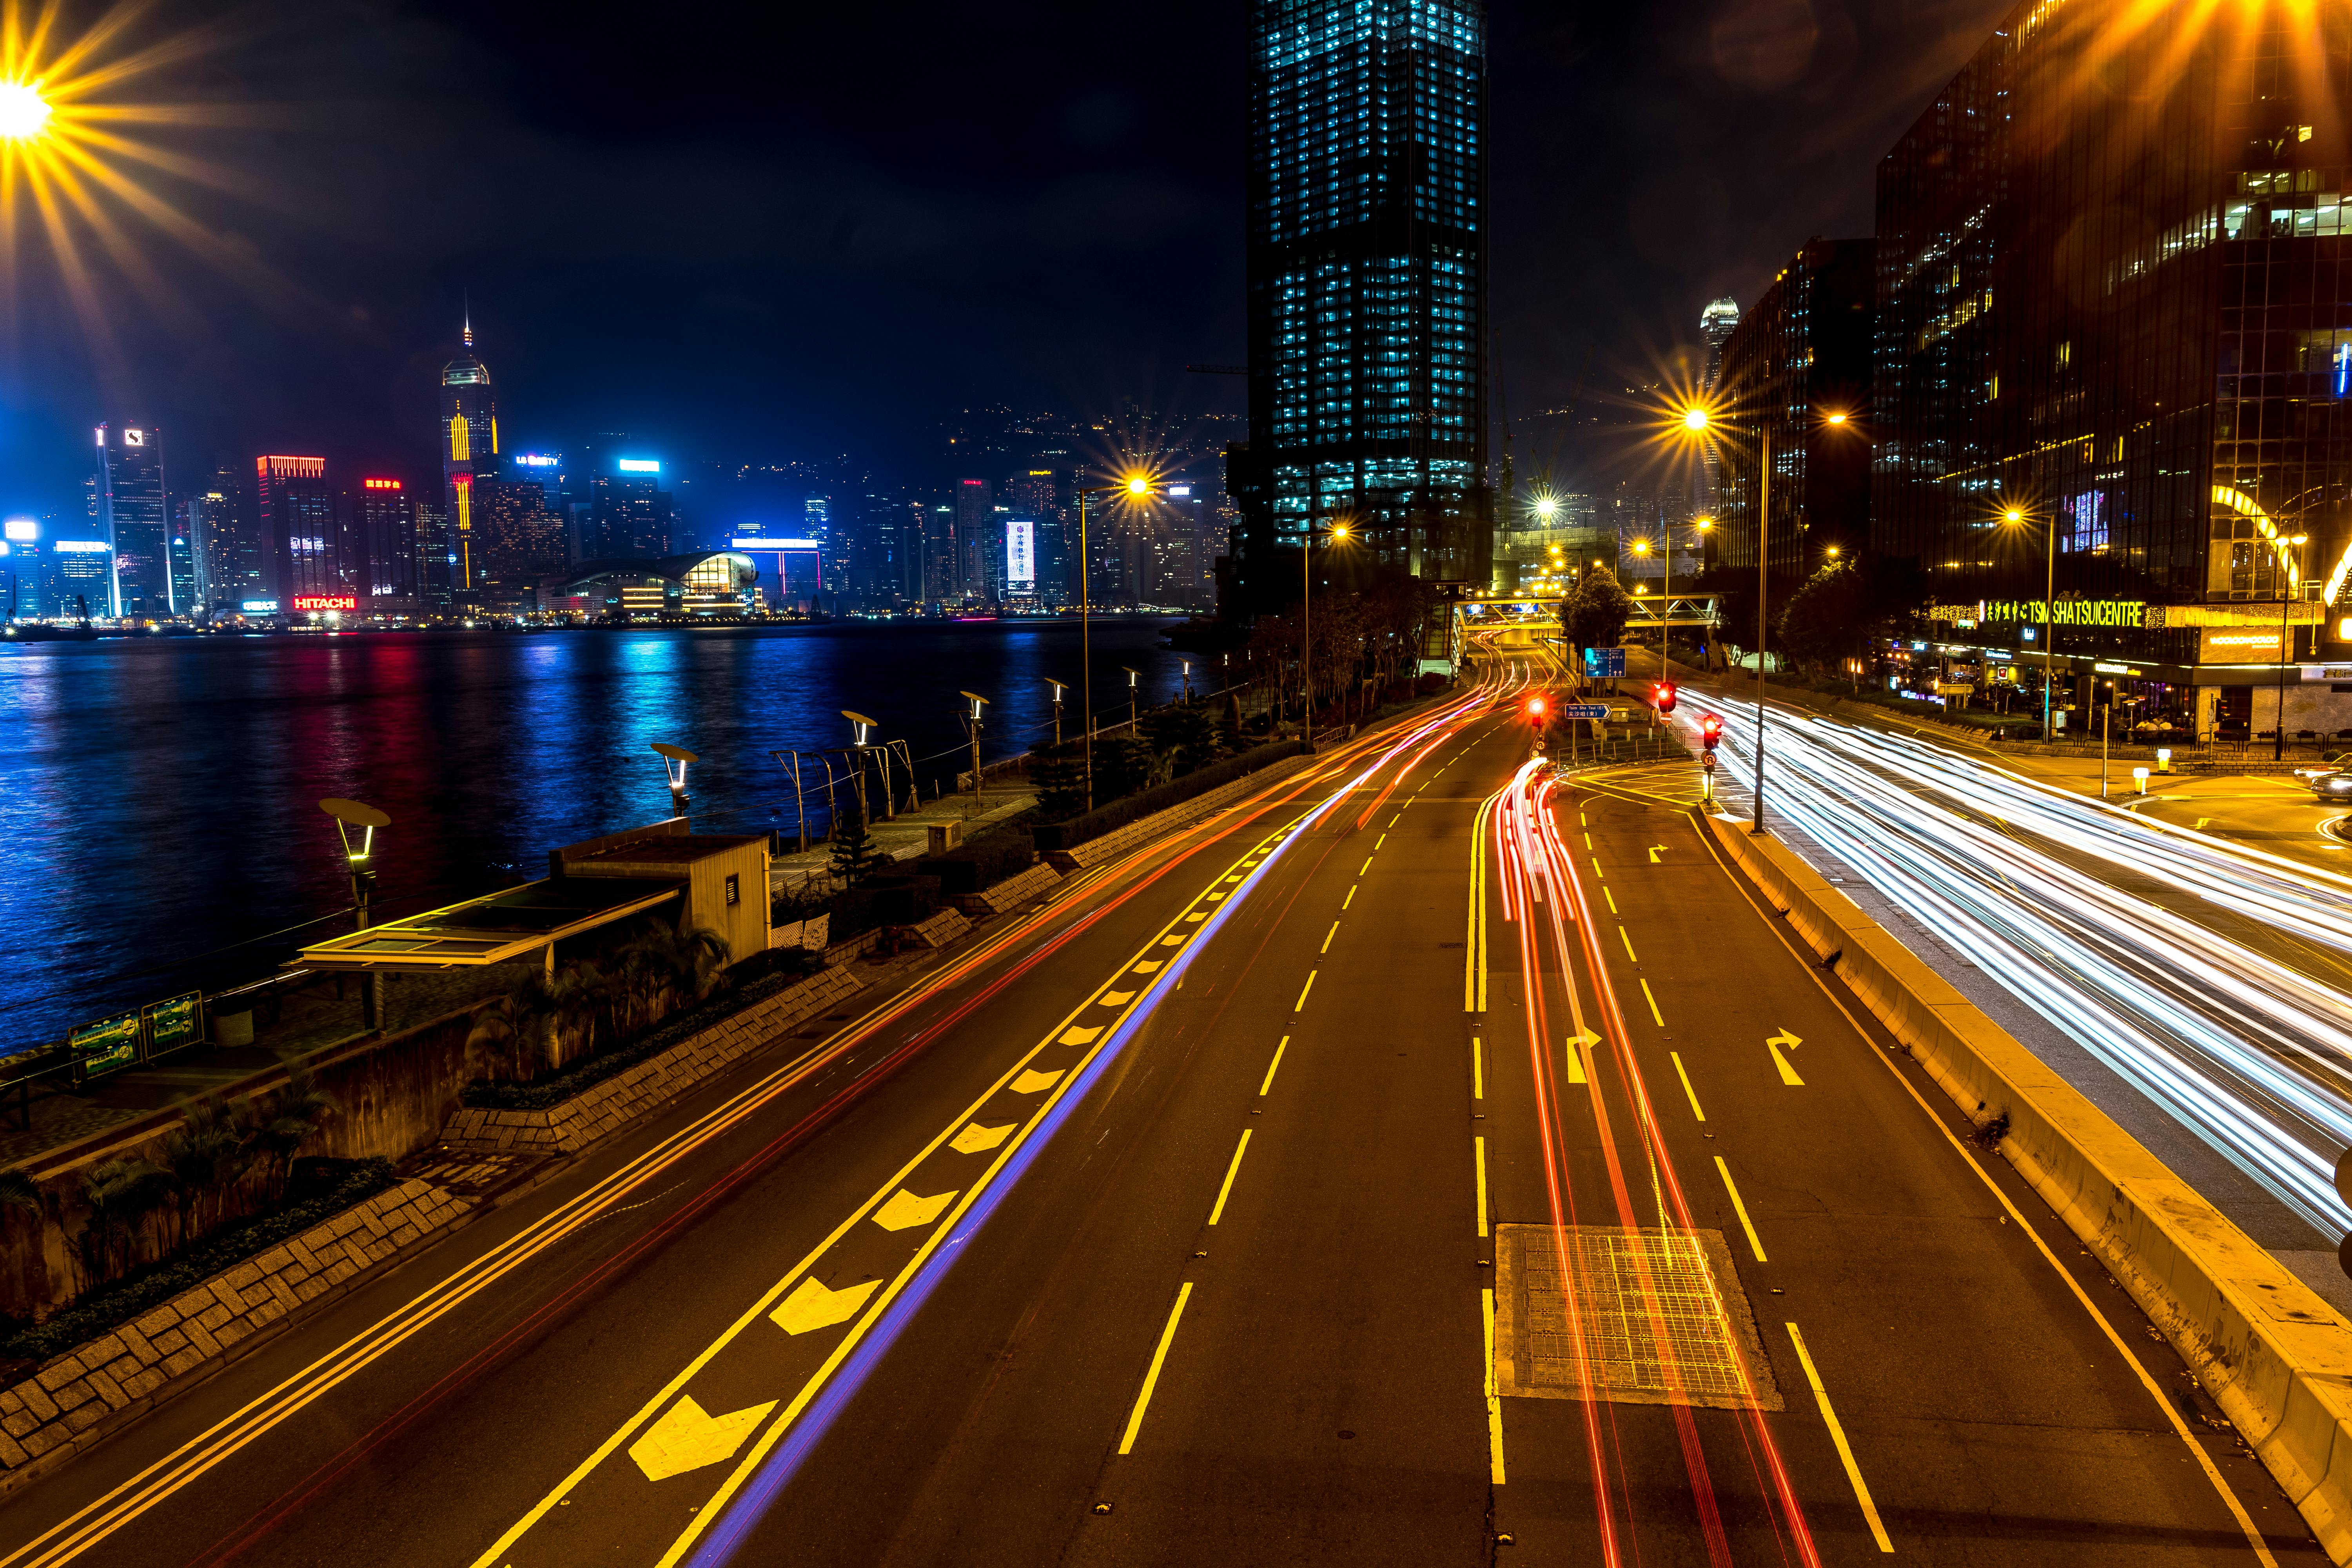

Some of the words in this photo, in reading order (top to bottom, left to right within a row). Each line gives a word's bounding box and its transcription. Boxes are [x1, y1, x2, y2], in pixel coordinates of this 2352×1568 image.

[295, 598, 355, 608] HITACHI
[1987, 601, 2027, 622] 尖沙咀中心
[2053, 601, 2074, 624] SHA
[2075, 600, 2098, 625] TSUI
[2098, 600, 2143, 627] CENTRE
